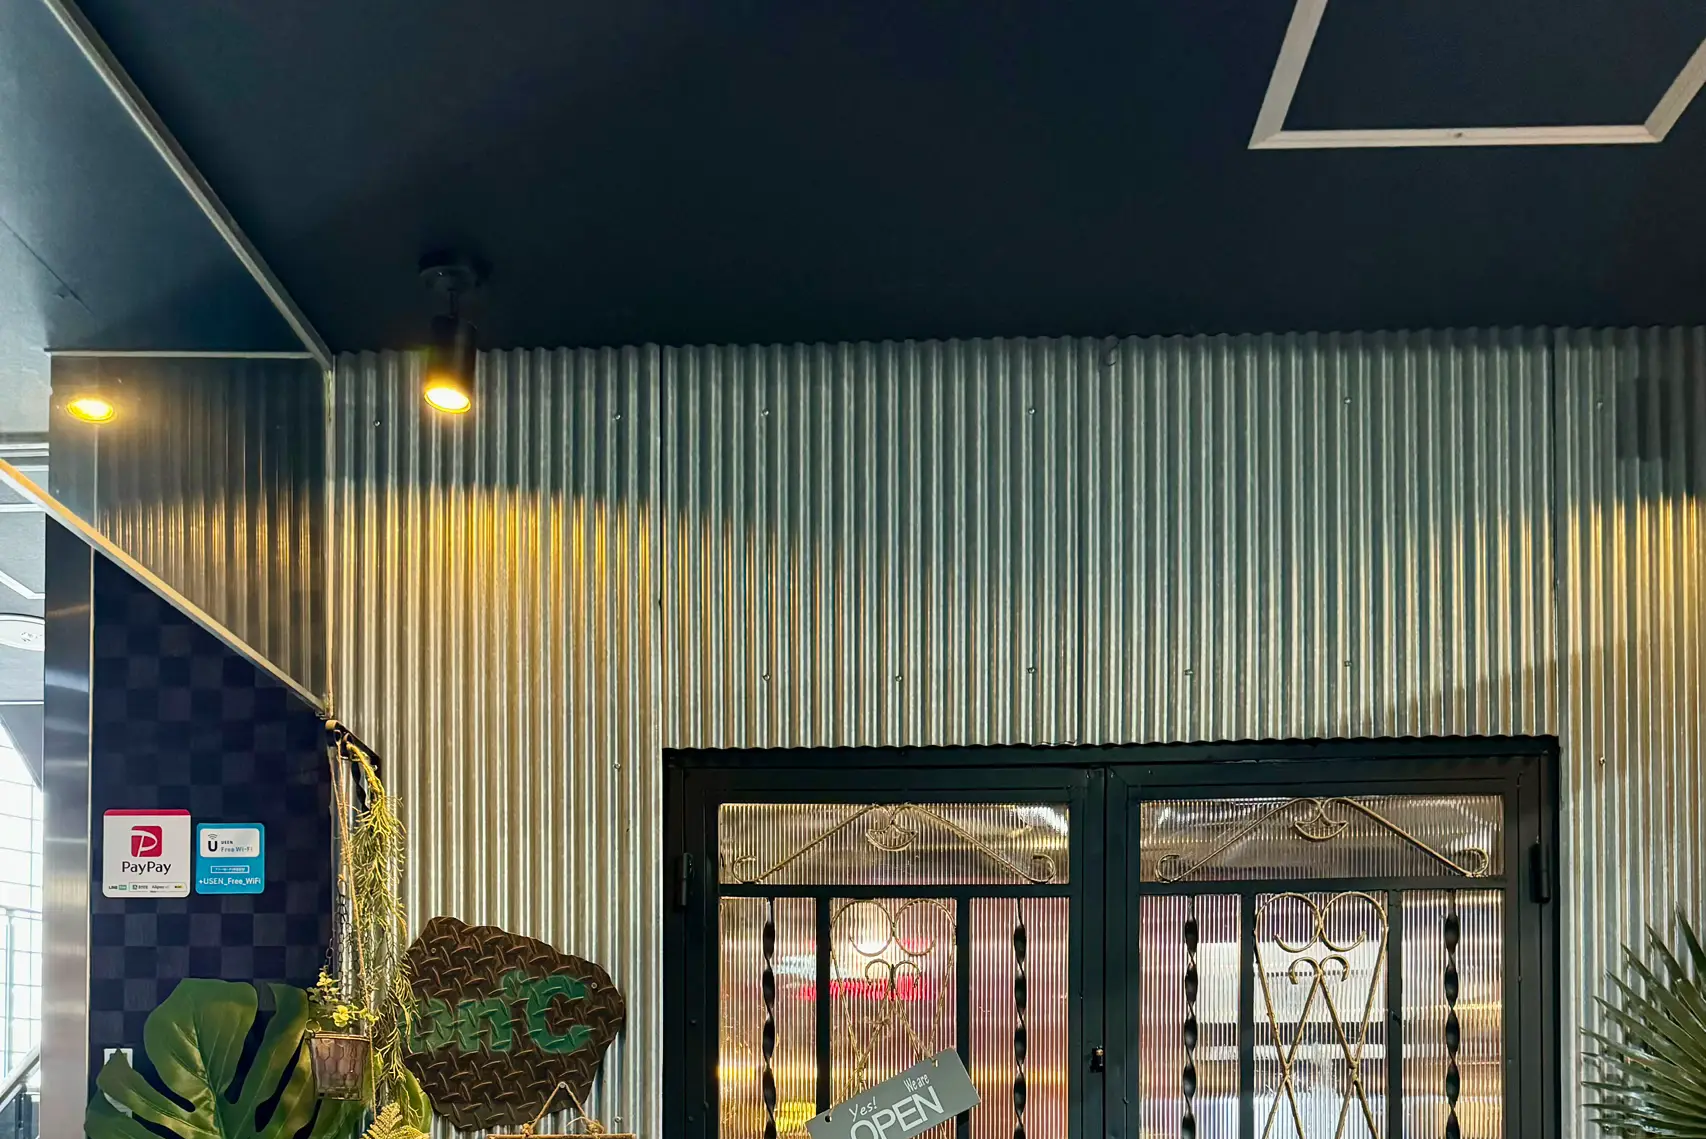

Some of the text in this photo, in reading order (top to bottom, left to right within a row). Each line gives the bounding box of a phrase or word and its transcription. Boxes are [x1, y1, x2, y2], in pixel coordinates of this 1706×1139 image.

[207, 840, 218, 852] U
[121, 861, 172, 876] PayPay
[903, 1073, 930, 1093] We are
[848, 1096, 878, 1122] Yes!
